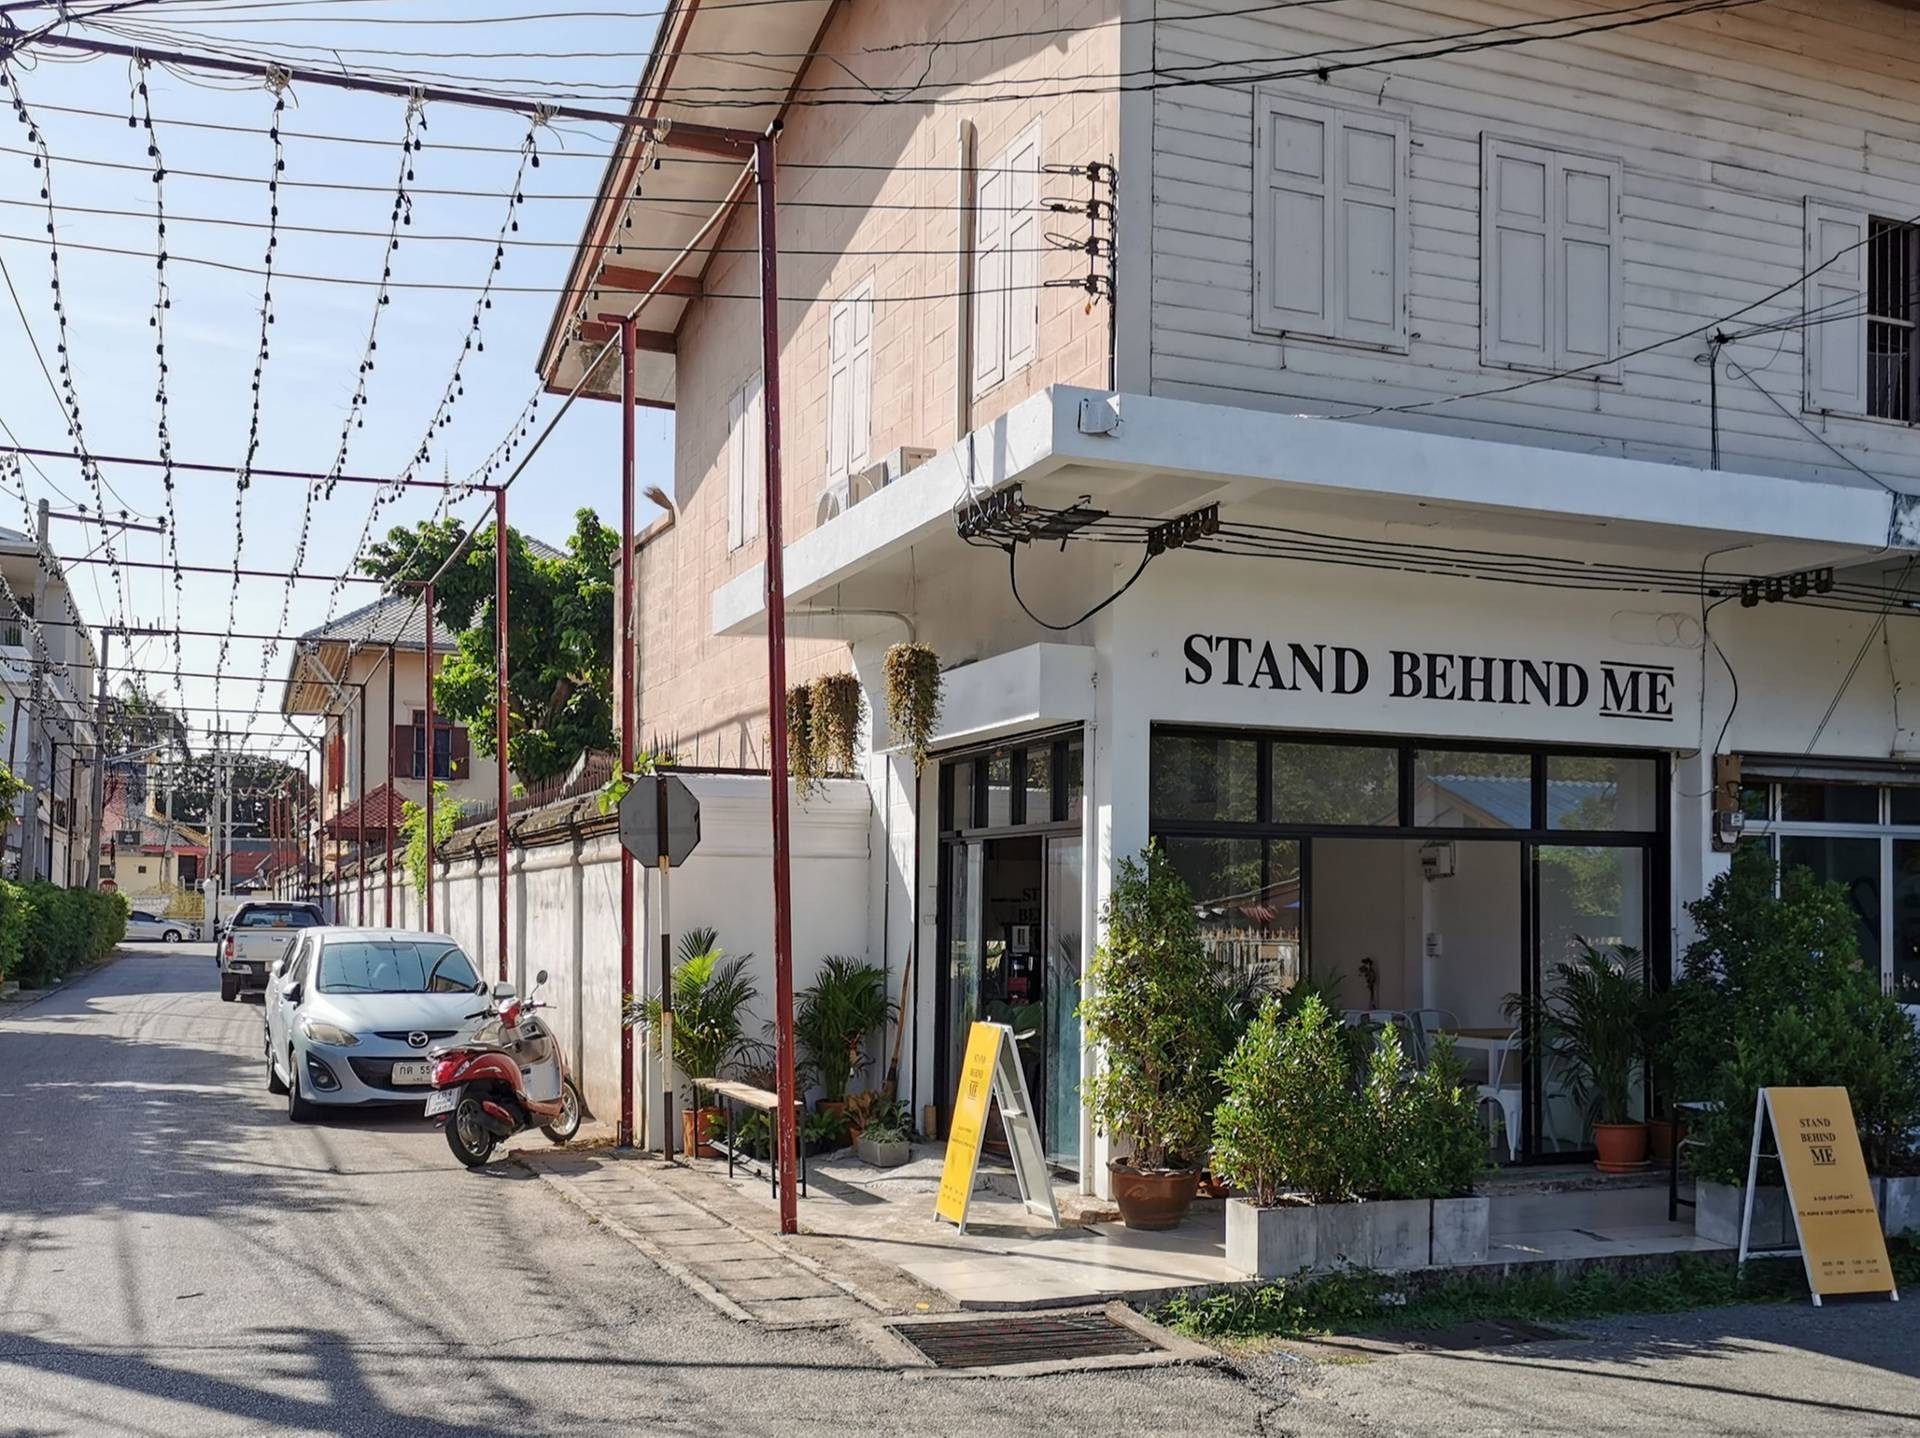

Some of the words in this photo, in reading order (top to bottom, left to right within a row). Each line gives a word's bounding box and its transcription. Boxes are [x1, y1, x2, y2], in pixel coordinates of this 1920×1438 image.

[1182, 632, 1369, 695] STAND
[1388, 649, 1589, 708] BEHIND
[1600, 666, 1674, 717] ME
[1799, 1118, 1831, 1128] STAND
[1800, 1132, 1836, 1143] BEHIND
[1811, 1148, 1836, 1163] ME
